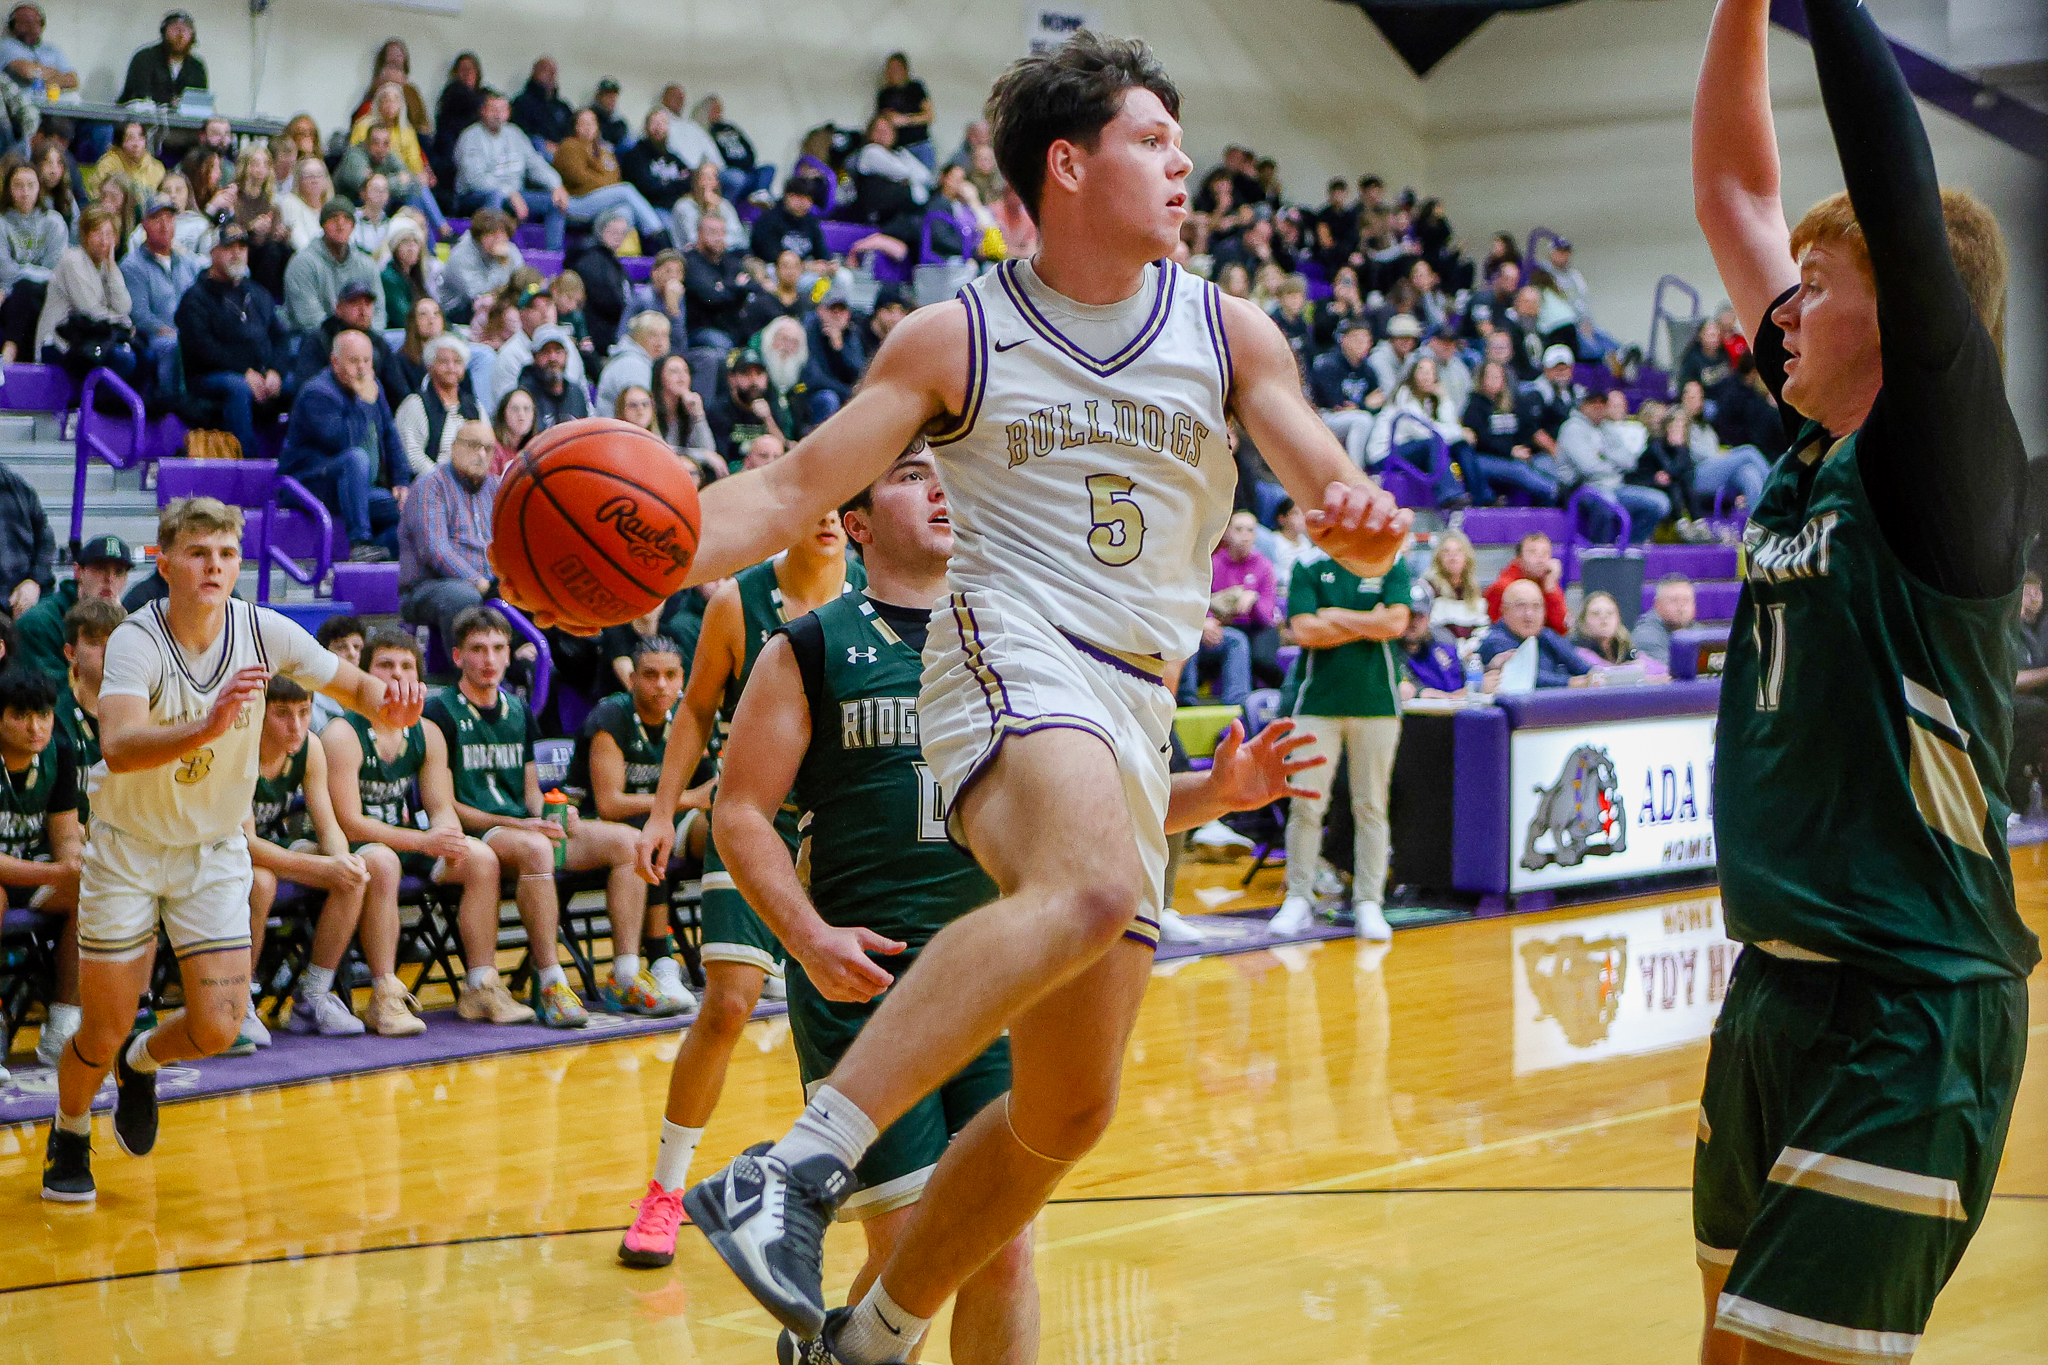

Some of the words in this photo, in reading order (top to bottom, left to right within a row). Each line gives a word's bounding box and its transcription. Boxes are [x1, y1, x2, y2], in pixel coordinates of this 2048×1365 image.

[1006, 400, 1209, 469] BULLDOGS
[1085, 473, 1148, 567] 5
[1638, 762, 1698, 827] ADA
